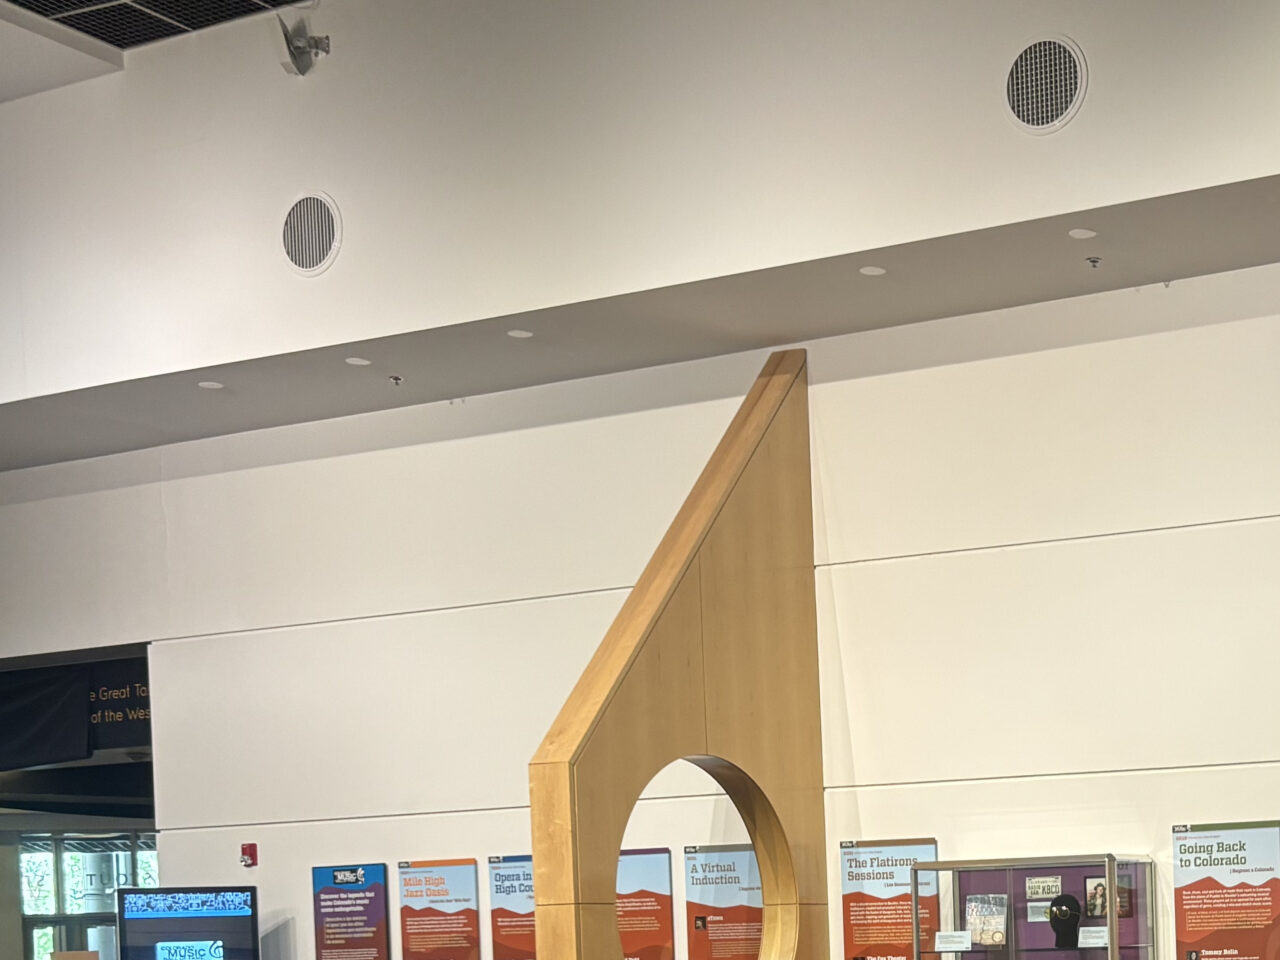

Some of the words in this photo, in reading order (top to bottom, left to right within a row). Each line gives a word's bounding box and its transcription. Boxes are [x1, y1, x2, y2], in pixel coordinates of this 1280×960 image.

[100, 685, 130, 700] Great
[134, 684, 149, 696] Ta
[91, 712, 101, 723] of
[105, 710, 123, 722] the
[126, 708, 150, 720] Wes
[1179, 843, 1213, 855] Going
[1217, 841, 1246, 851] Back
[847, 859, 867, 868] The
[870, 856, 917, 868] Flatirons
[1180, 858, 1191, 868] to
[1194, 855, 1246, 867] Colorado
[691, 864, 698, 873] A
[701, 862, 736, 873] Virtual
[403, 877, 422, 886] Mile
[424, 876, 445, 887] High
[495, 872, 521, 884] Opera
[523, 871, 532, 880] in
[691, 875, 740, 886] Induction
[848, 871, 895, 881] Sessions
[404, 890, 424, 898] Jazz
[426, 888, 449, 896] Oasis
[495, 884, 516, 895] High
[519, 884, 534, 892] Cou
[168, 948, 206, 959] MUSIC
